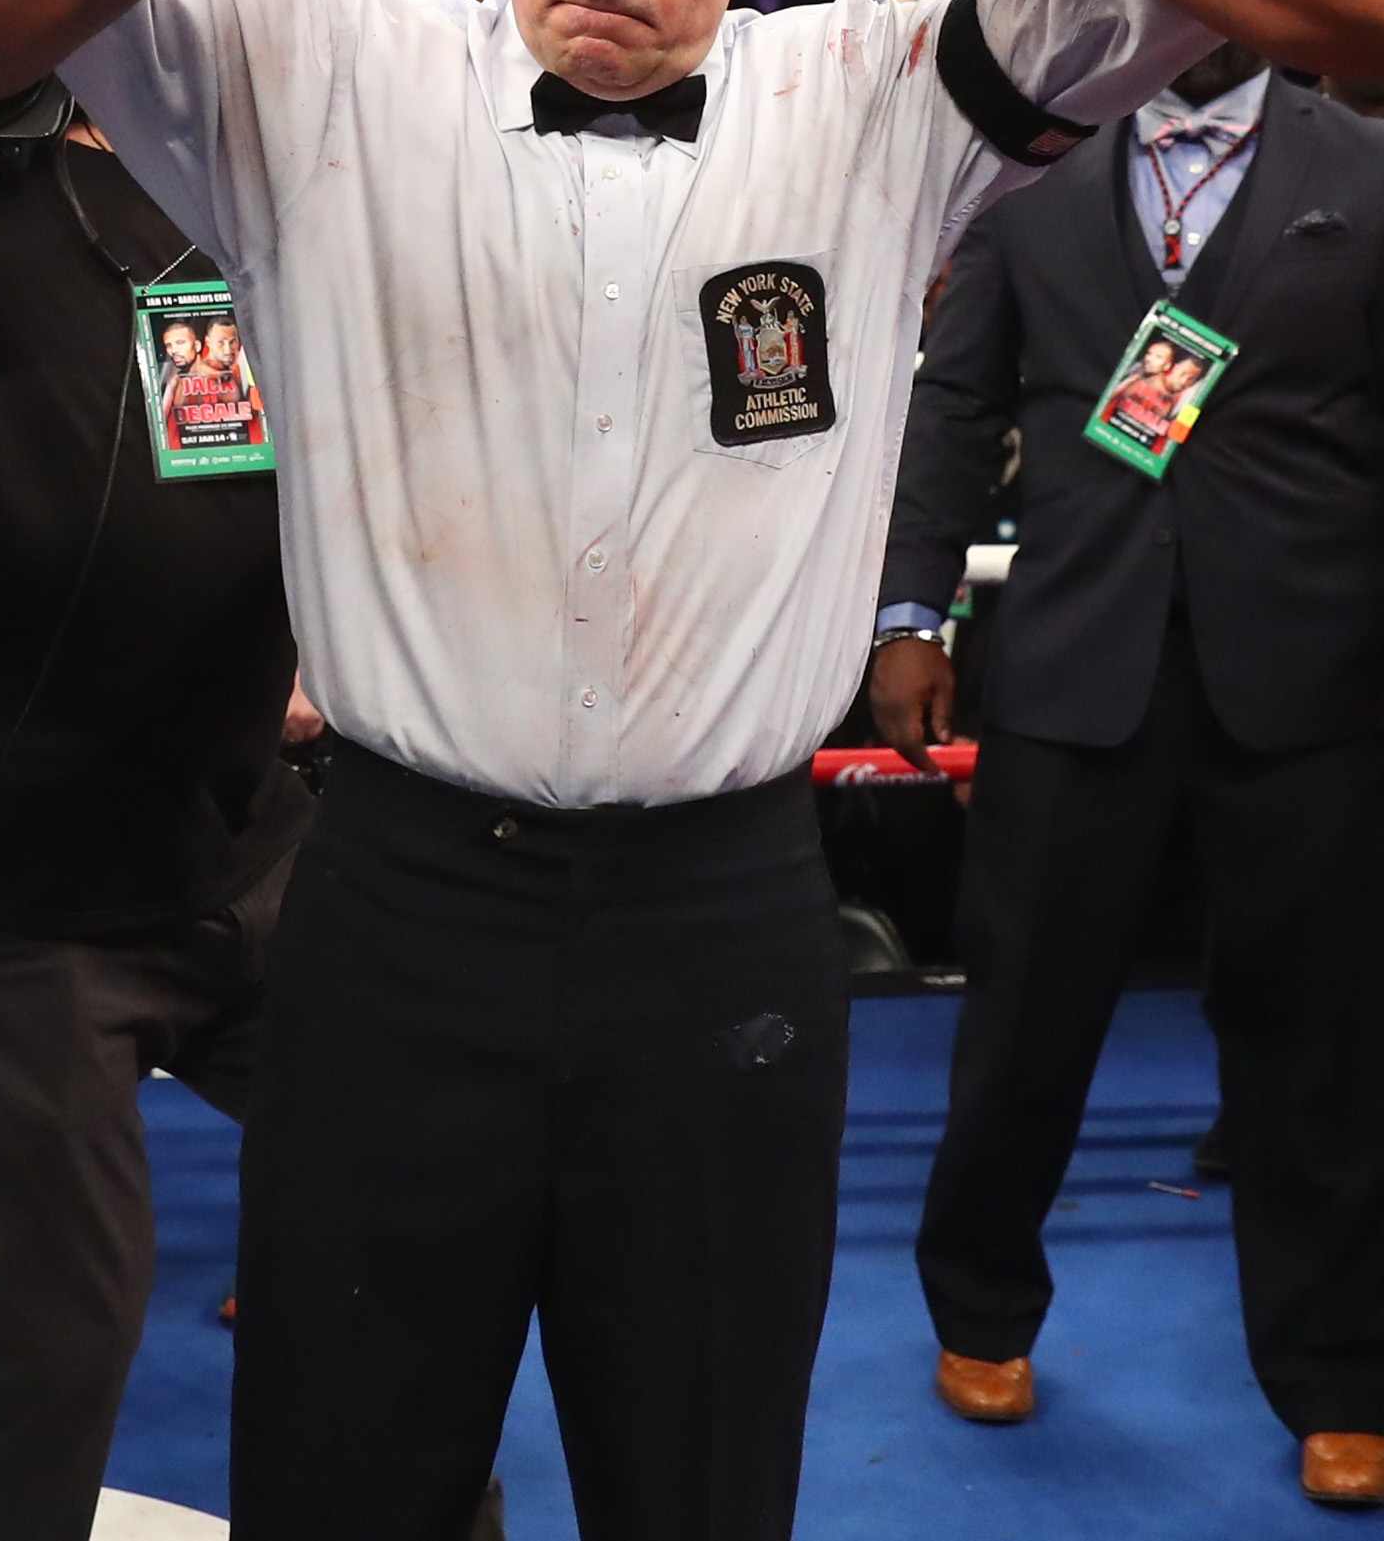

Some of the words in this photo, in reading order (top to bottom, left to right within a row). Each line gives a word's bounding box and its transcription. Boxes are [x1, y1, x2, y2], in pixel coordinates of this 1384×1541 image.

[214, 292, 232, 302] CENT
[716, 288, 742, 324] NEW
[738, 273, 777, 296] YORK
[780, 276, 814, 317] STATE
[182, 376, 235, 396] JACK
[746, 387, 807, 411] ATHLETIC
[173, 402, 253, 424] DEGALE
[735, 403, 818, 430] COMMISSION
